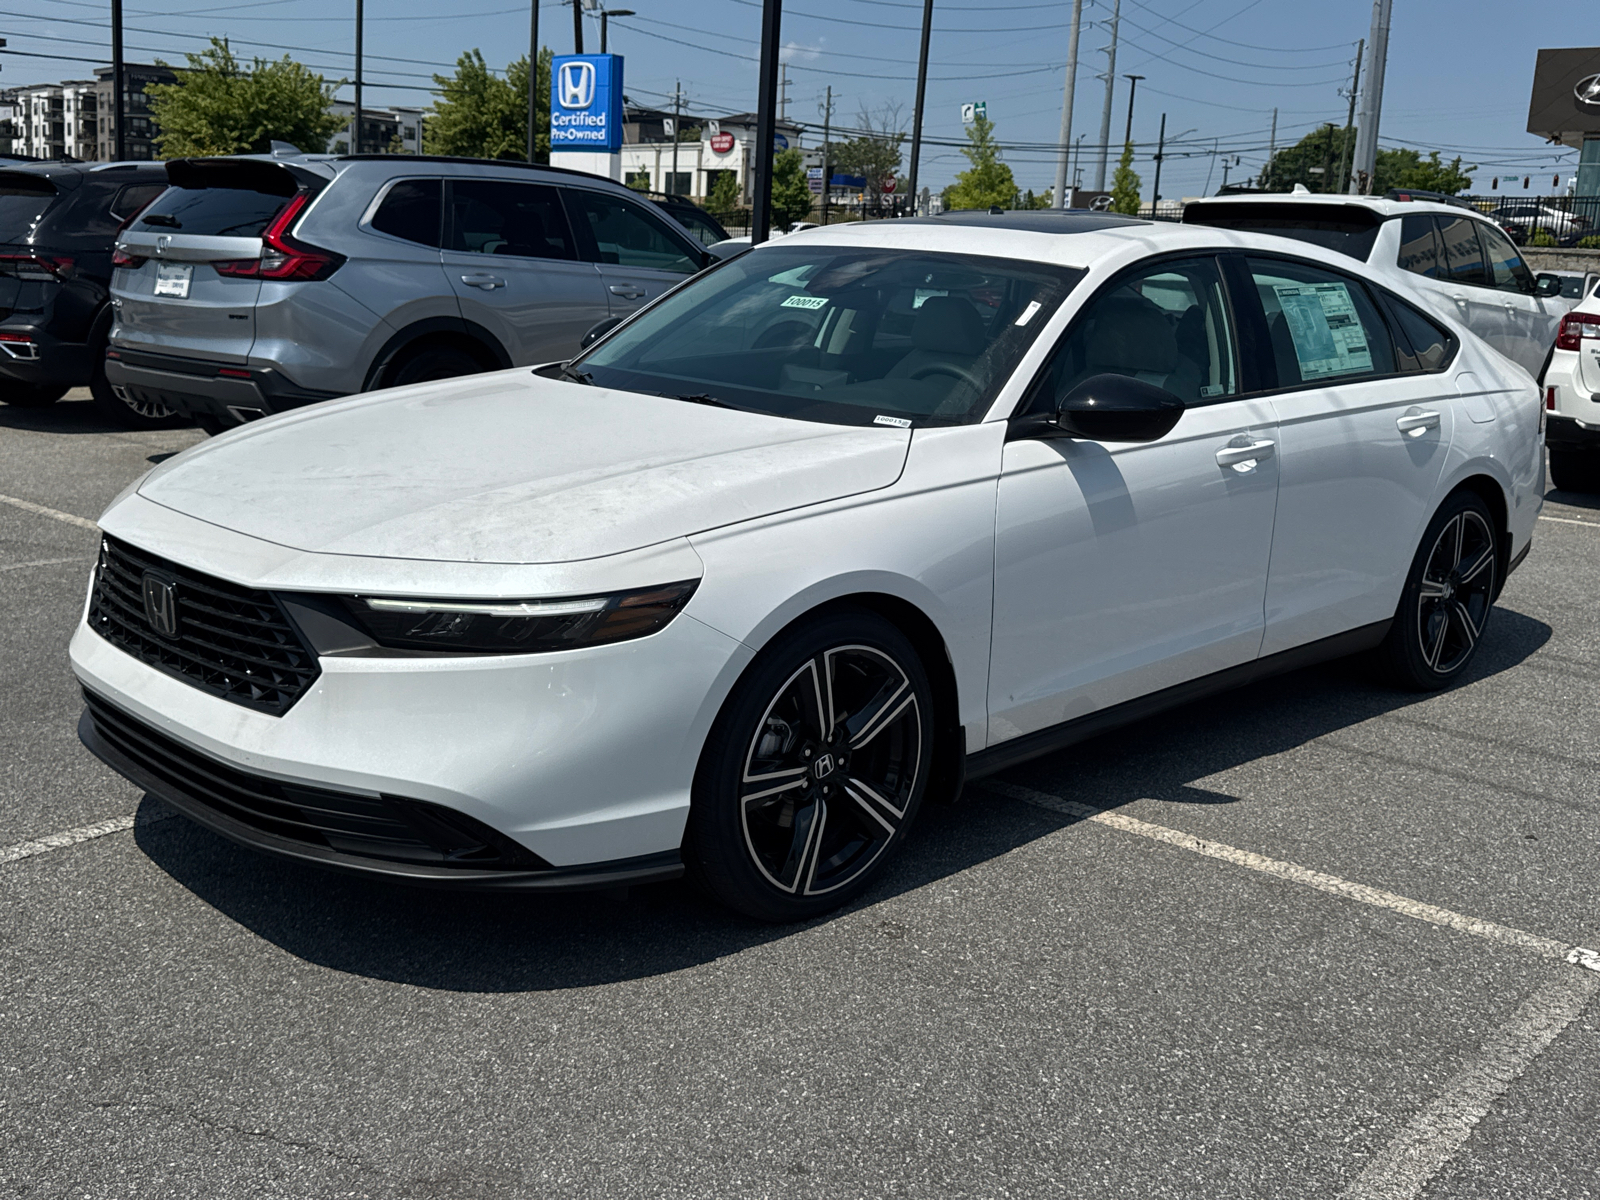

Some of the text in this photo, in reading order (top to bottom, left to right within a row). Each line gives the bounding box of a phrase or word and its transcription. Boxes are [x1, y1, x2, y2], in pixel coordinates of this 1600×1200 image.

[552, 112, 605, 126] Certified
[552, 128, 605, 140] Pre-Owned
[786, 297, 823, 307] 100015
[876, 416, 902, 425] 100015
